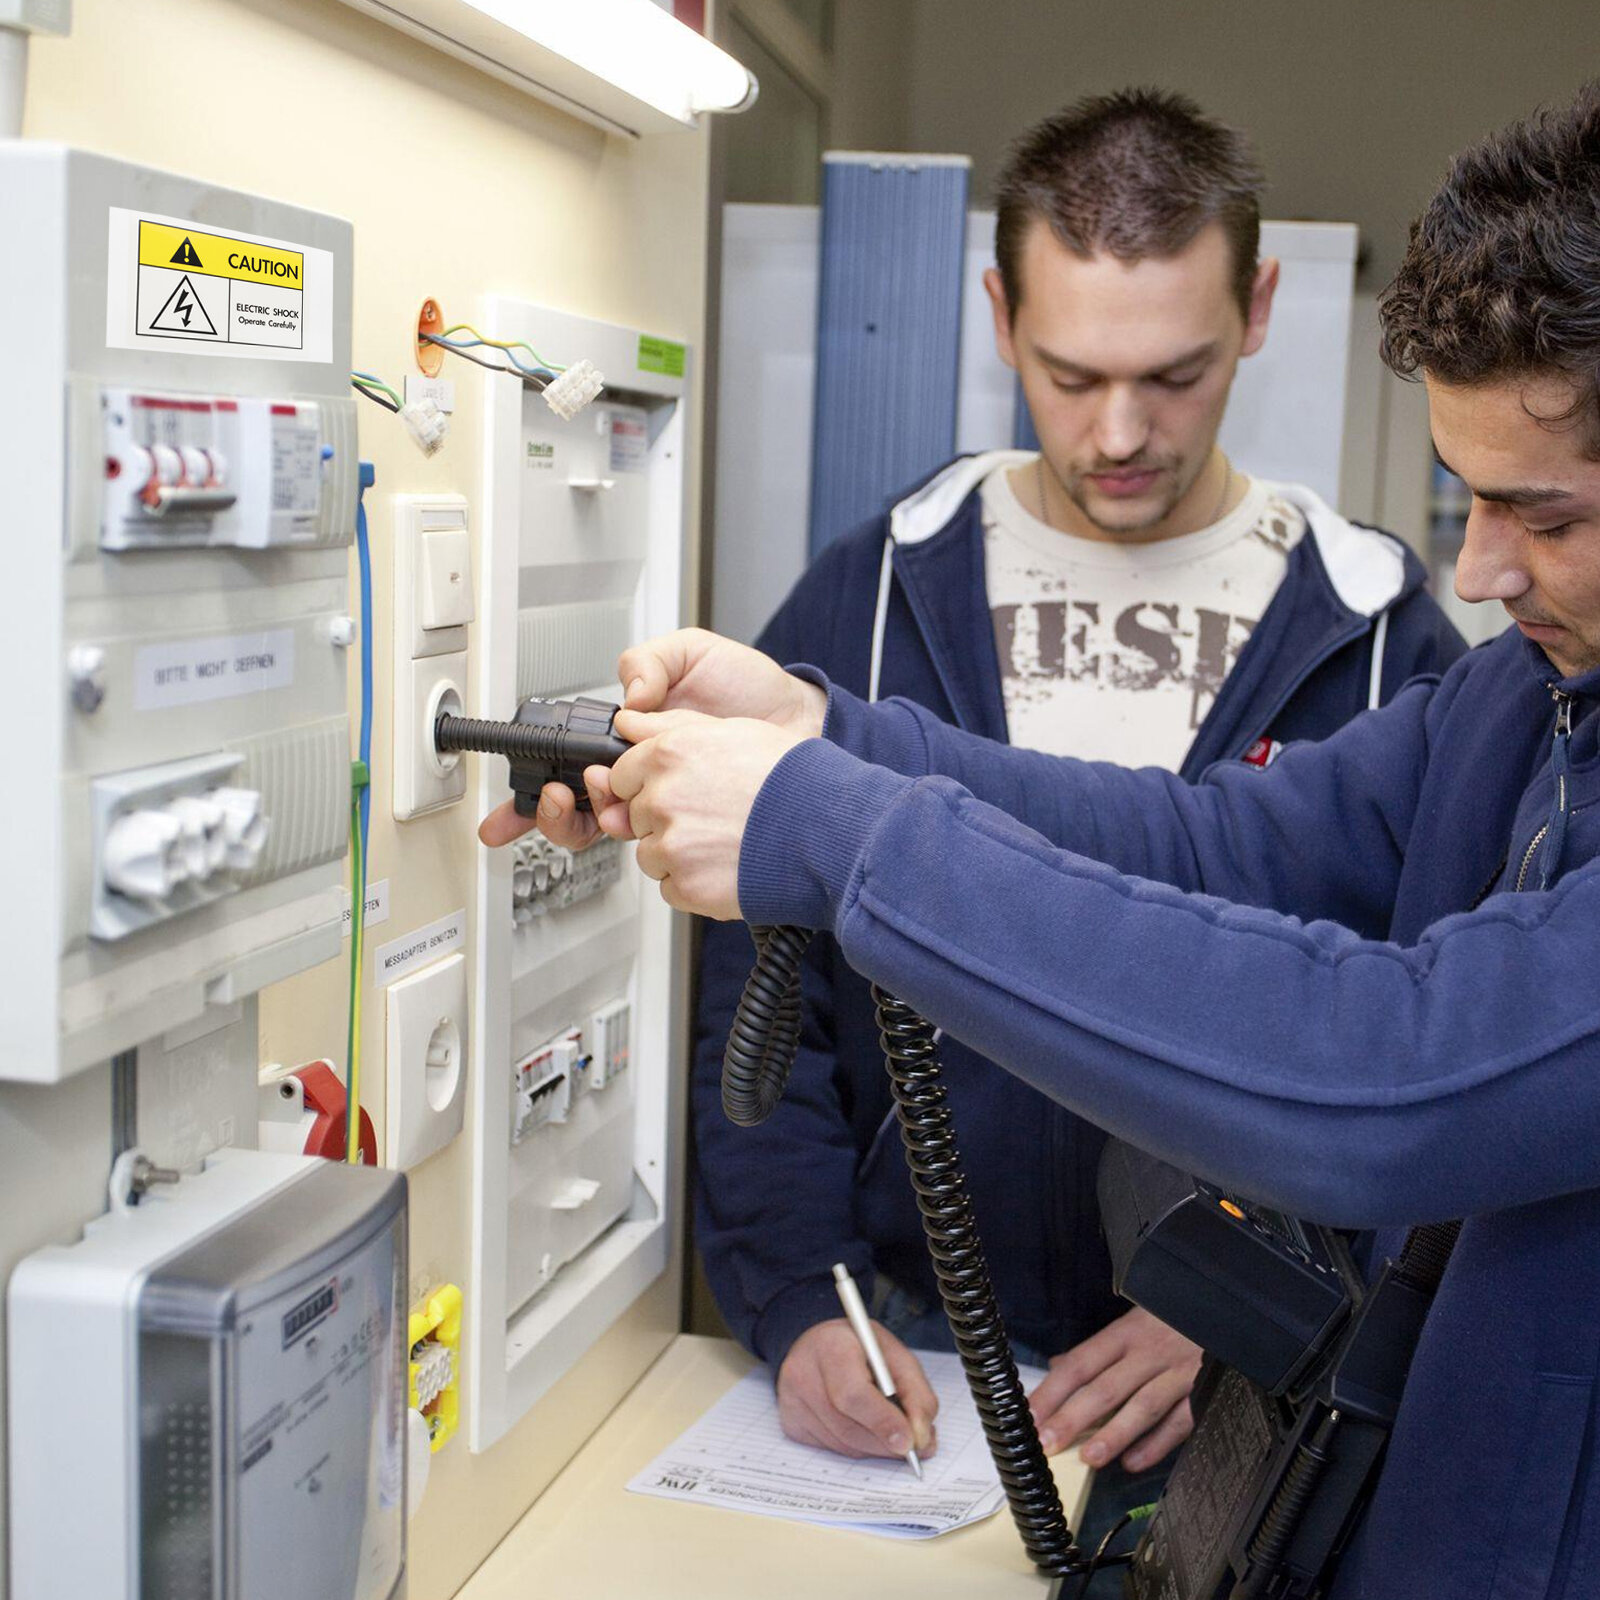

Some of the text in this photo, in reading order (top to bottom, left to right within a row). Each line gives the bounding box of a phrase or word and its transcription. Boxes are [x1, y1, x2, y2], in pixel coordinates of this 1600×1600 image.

[228, 253, 299, 280] CAUTION
[236, 303, 299, 319] ELECTRIC SHOCK
[238, 316, 297, 331] Operate Carefully
